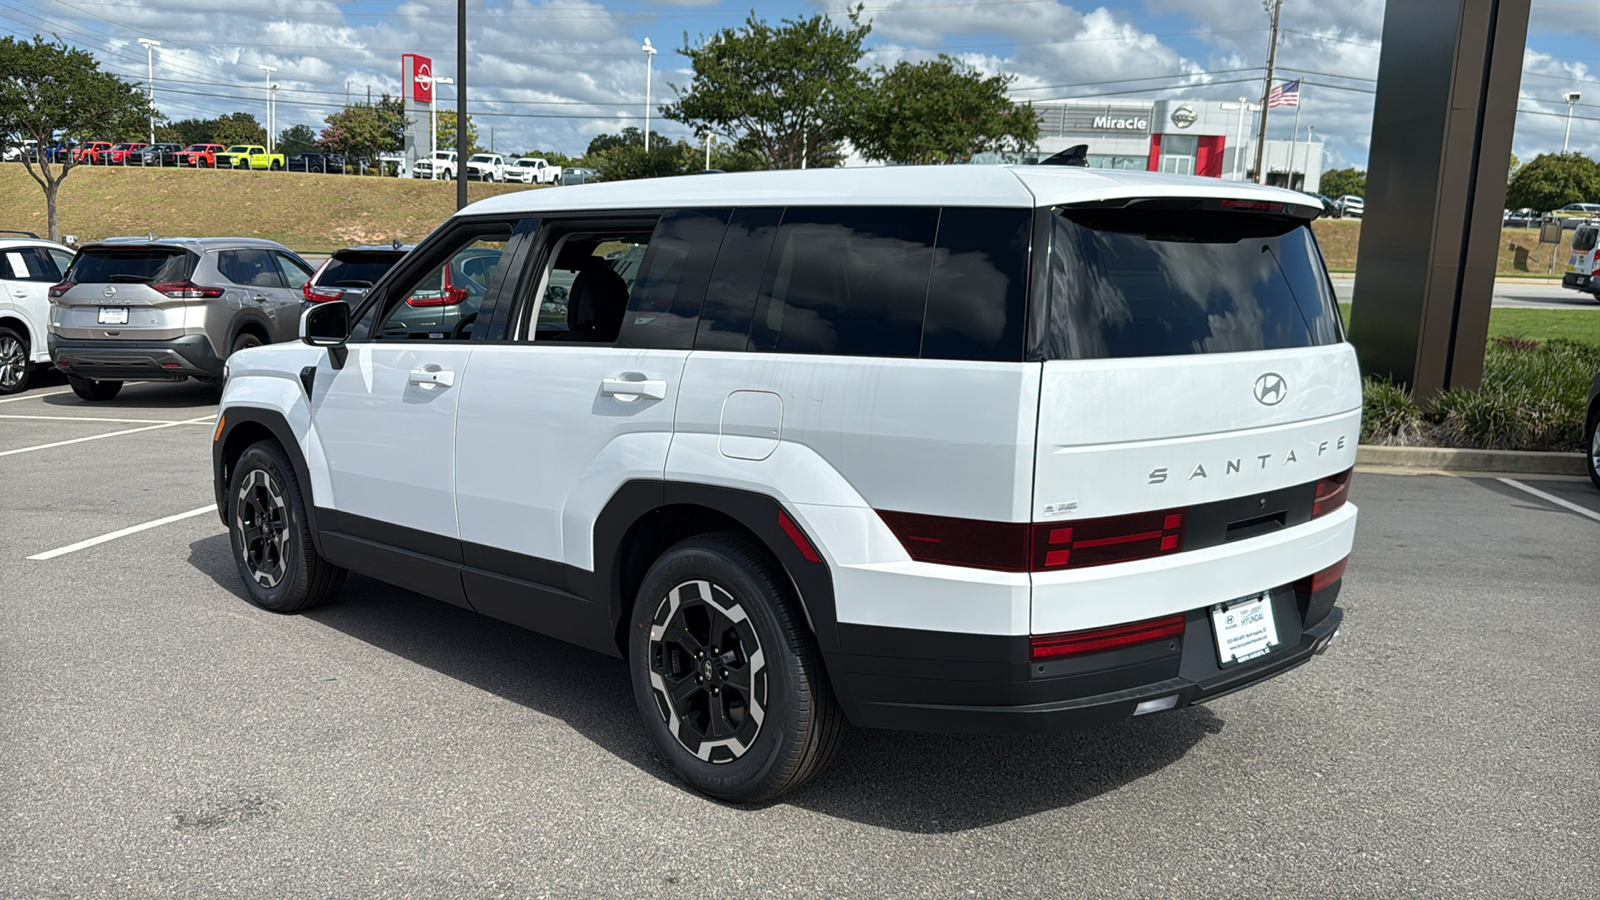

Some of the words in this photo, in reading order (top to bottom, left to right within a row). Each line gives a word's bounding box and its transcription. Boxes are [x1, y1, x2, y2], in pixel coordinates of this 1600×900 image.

[1092, 115, 1147, 130] Miracle
[1271, 164, 1302, 173] Servce
[1148, 449, 1298, 485] SANTA
[1317, 435, 1346, 456] FE
[1240, 612, 1264, 627] HYUNDAI
